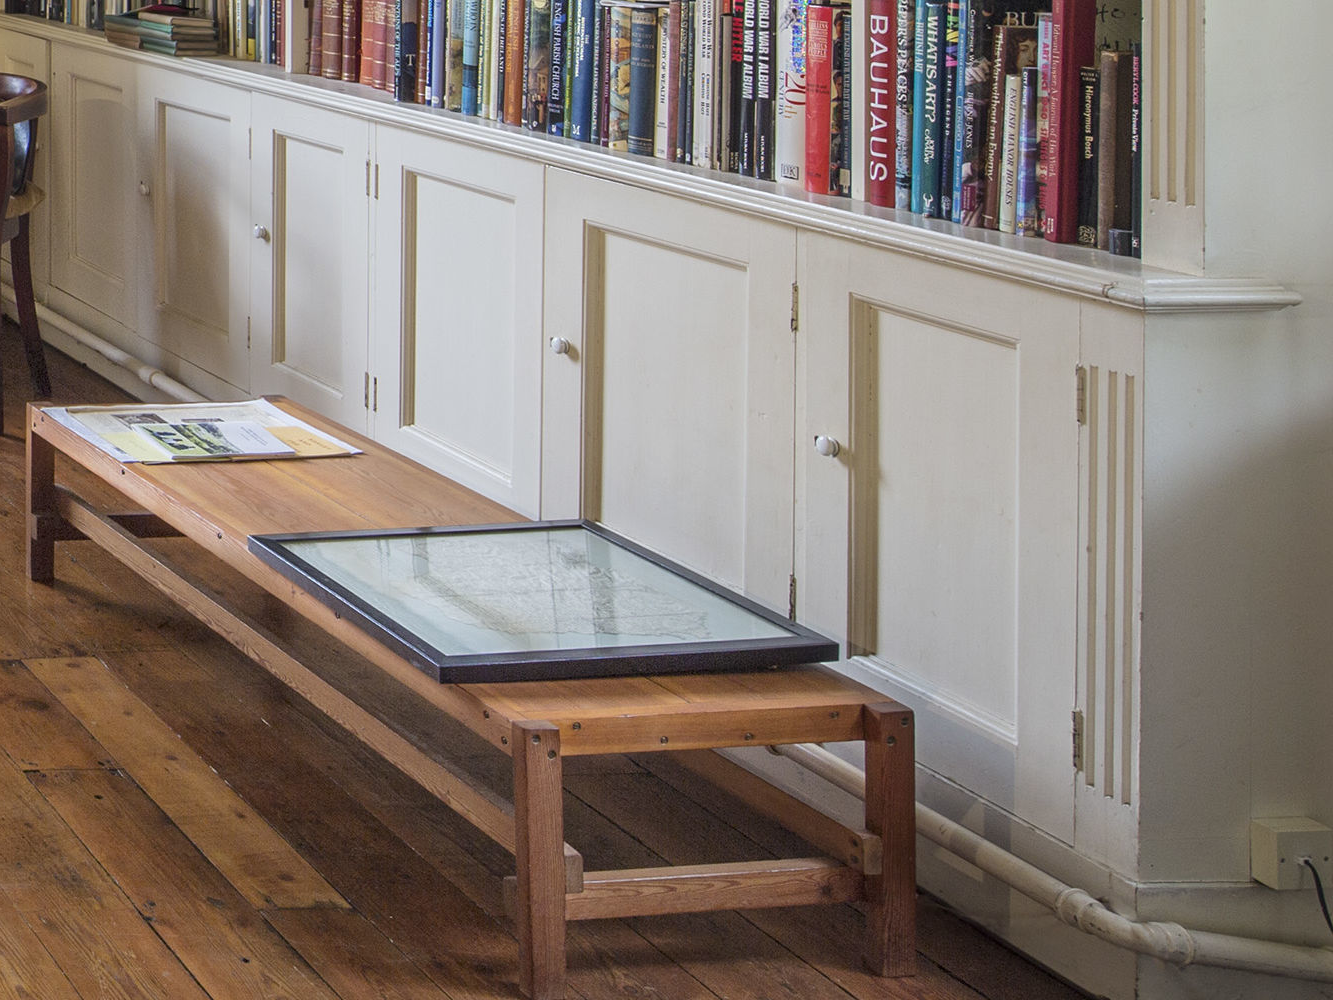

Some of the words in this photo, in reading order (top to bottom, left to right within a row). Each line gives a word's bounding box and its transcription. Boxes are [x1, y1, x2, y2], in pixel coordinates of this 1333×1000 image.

[470, 1, 478, 19] WHO
[470, 22, 477, 31] IN
[500, 18, 505, 29] OF
[553, 3, 562, 36] ENGLISH
[553, 37, 561, 64] PARISH
[732, 18, 743, 62] HITLER
[744, 30, 754, 52] WAR
[759, 31, 769, 54] WAR
[915, 23, 923, 55] BRITISH
[927, 16, 938, 62] WHAT
[743, 63, 753, 99] ALBUM
[758, 62, 769, 98] ALBUM
[897, 49, 907, 101] PLACES
[915, 57, 923, 72] ART
[927, 64, 937, 79] IS
[993, 59, 1001, 82] War
[551, 65, 560, 100] CHURCH
[869, 14, 888, 181] BAUHAUS
[925, 80, 935, 122] ART?
[990, 83, 999, 126] without
[1008, 88, 1017, 128] ENGLISH
[1084, 86, 1093, 133] Hieronymus
[965, 92, 974, 148] BURNE-JONES
[990, 129, 996, 140] an
[985, 142, 997, 181] Enemy
[1006, 133, 1015, 166] MANOR
[1085, 137, 1093, 159] Bosch
[782, 165, 796, 177] DK
[1005, 170, 1014, 206] HOUSES
